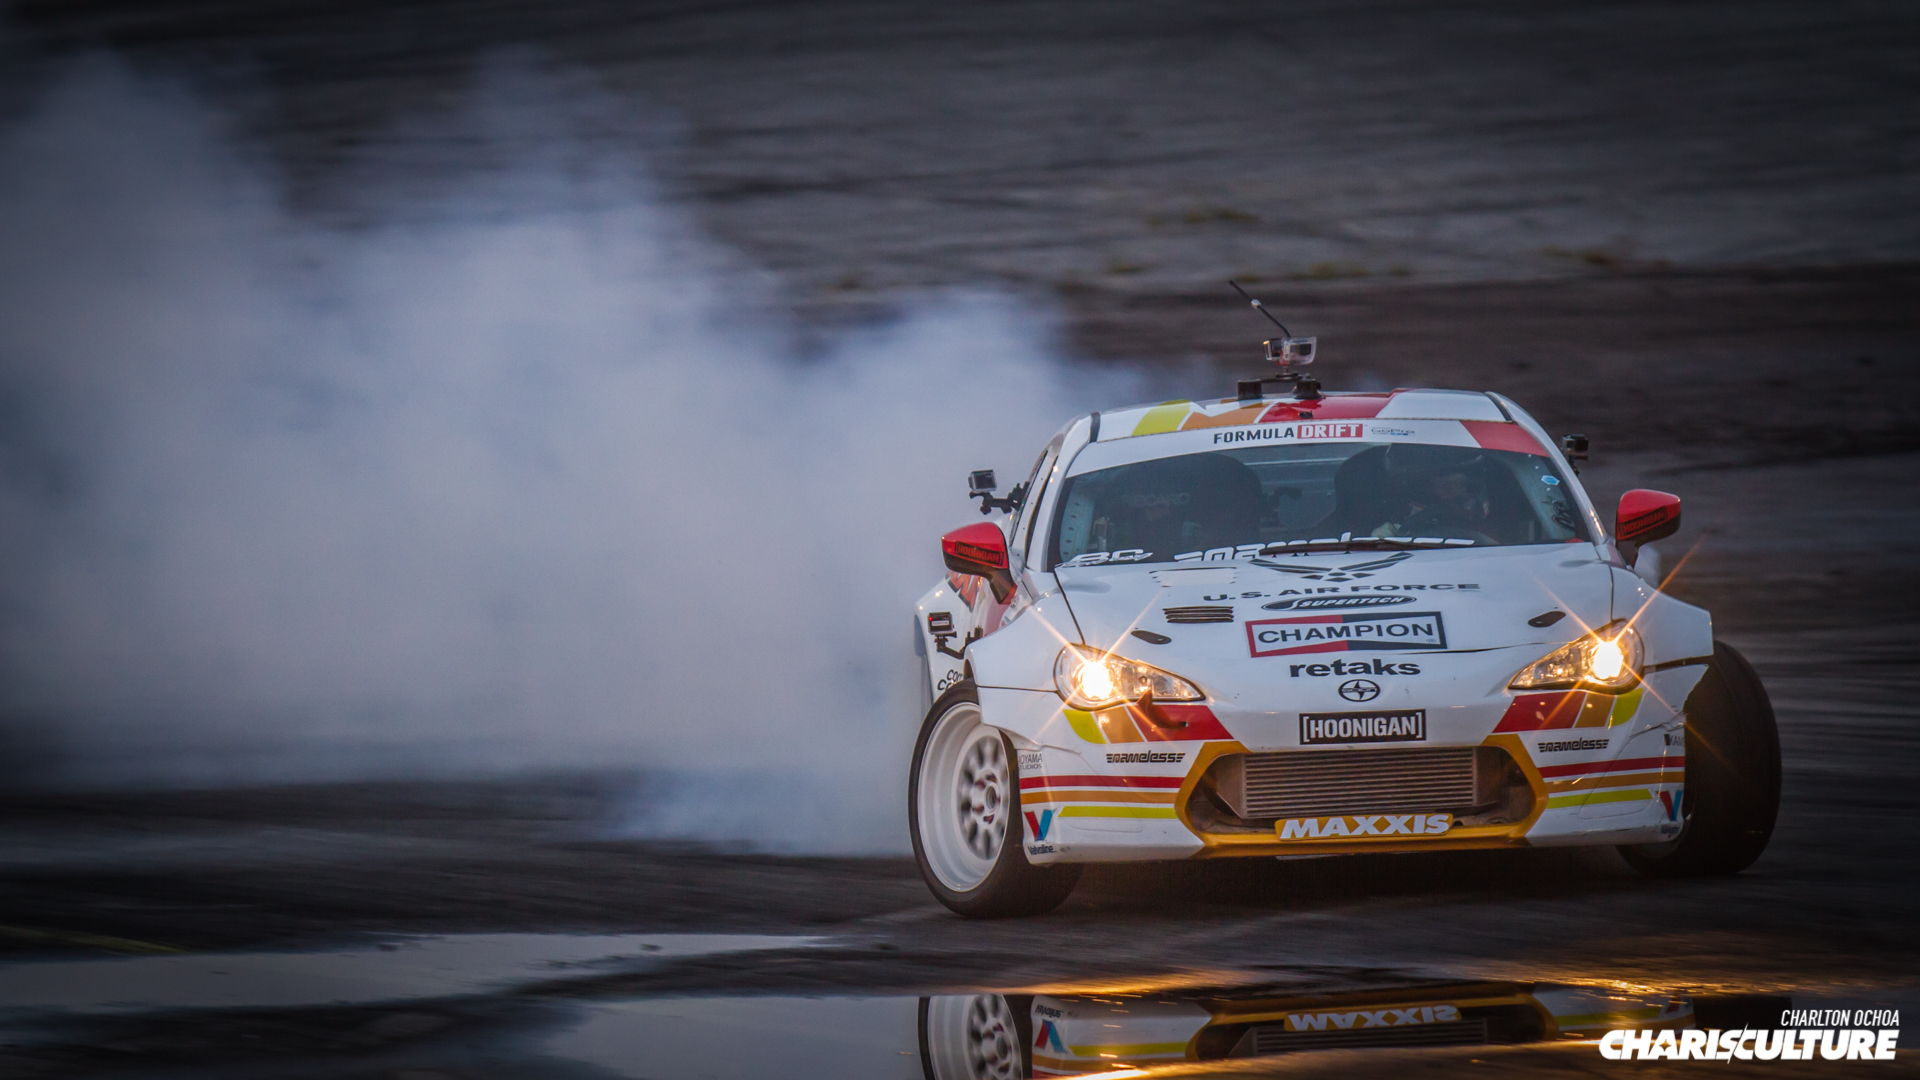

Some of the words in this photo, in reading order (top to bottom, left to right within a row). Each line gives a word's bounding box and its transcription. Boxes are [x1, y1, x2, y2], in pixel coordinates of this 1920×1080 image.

[1213, 427, 1294, 444] FORMULA
[1300, 424, 1361, 438] DRIFT
[1203, 592, 1270, 601] U.S.
[1278, 586, 1340, 595] AIR
[1351, 583, 1481, 592] FORCE
[1258, 622, 1434, 643] CHAMPION
[1289, 658, 1421, 677] retaks
[1544, 737, 1604, 752] nameless
[1111, 750, 1177, 763] nameless
[1280, 814, 1450, 839] MAXXIS
